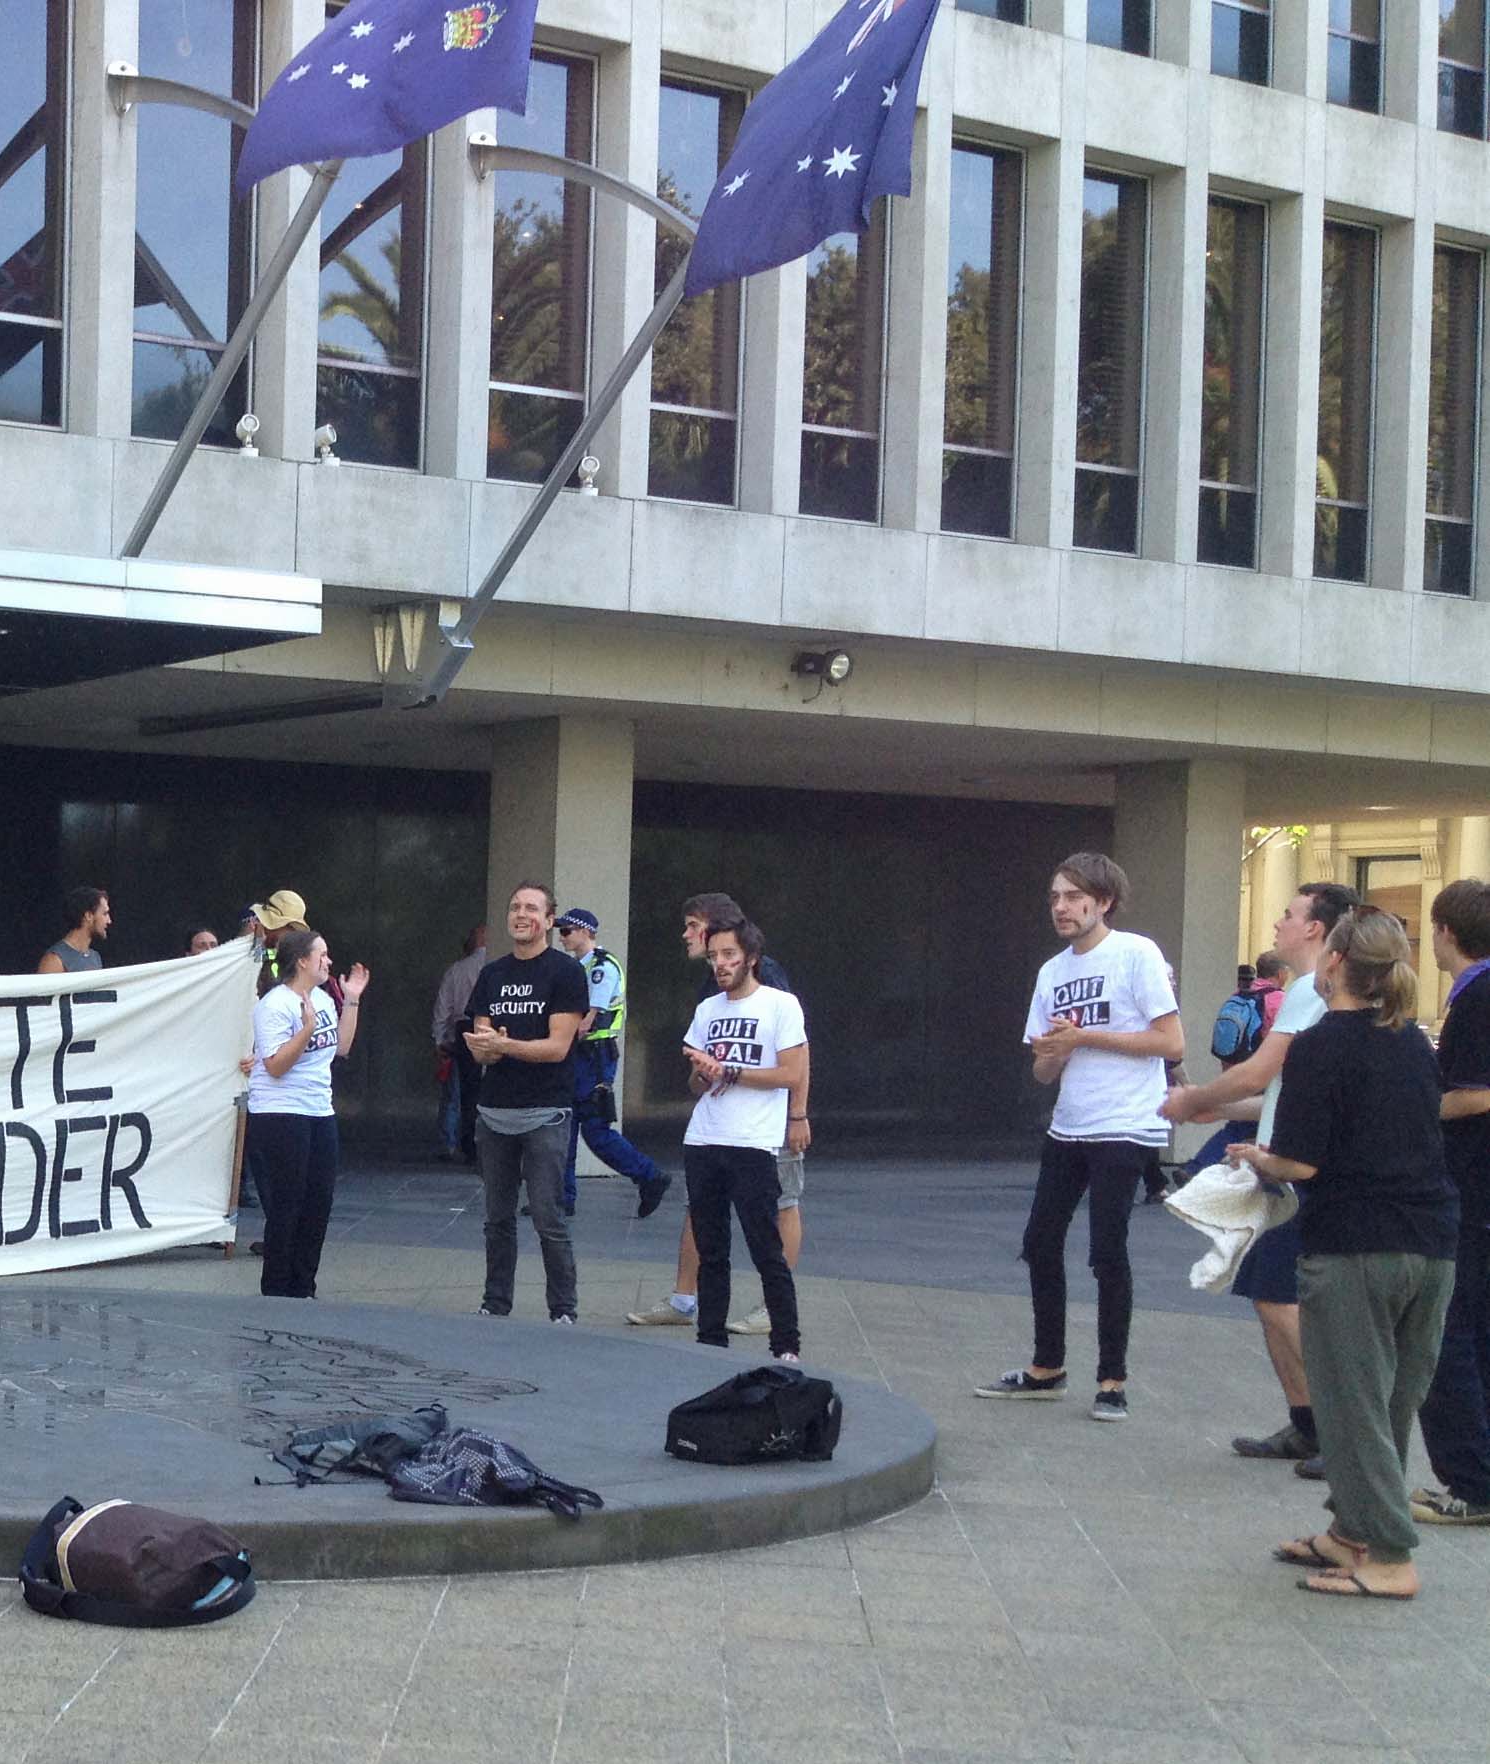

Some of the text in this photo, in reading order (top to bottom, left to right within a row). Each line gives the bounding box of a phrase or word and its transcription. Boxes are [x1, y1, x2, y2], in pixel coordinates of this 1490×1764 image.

[500, 984, 534, 998] FOOD
[1055, 977, 1104, 1006] QUIT
[489, 1001, 547, 1016] SECURITY
[709, 1019, 758, 1038] QUIT
